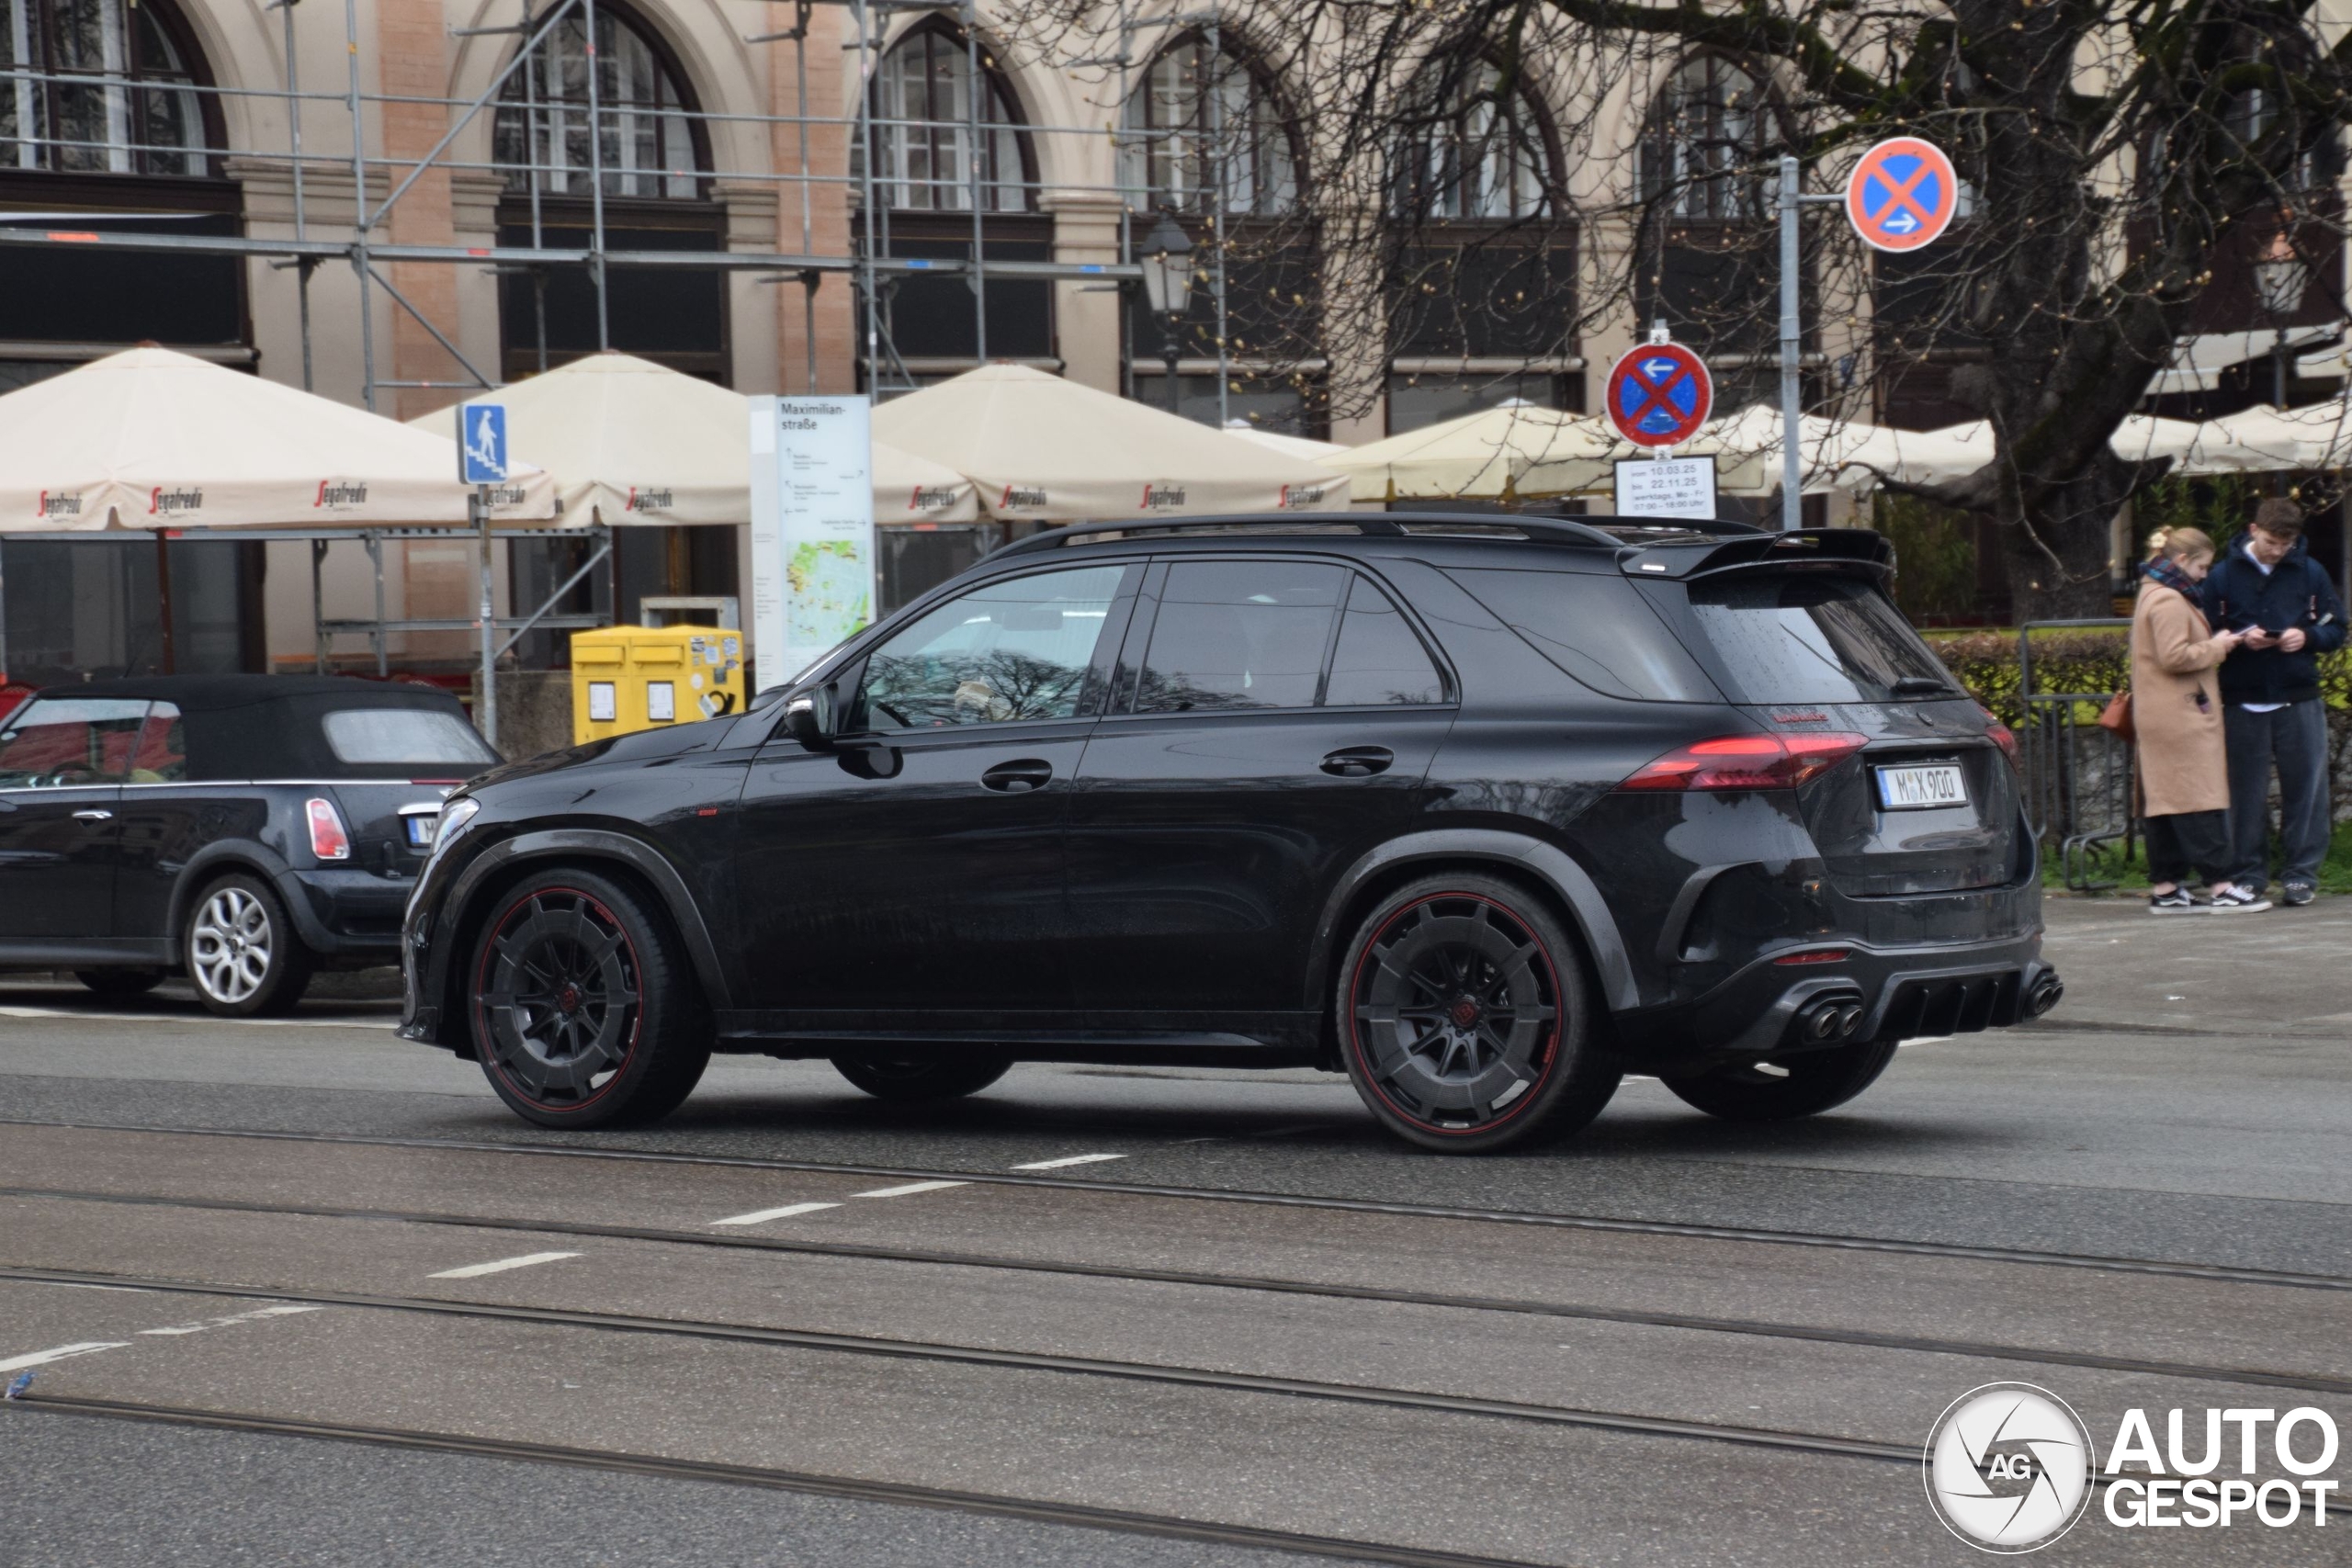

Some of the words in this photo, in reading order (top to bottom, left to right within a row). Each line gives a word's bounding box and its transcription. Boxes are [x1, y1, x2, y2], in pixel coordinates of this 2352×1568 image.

[781, 402, 846, 415] Maximilian-
[782, 418, 818, 430] straße
[1651, 464, 1697, 476] 10.03.25
[1651, 477, 1698, 489] 22.11.25
[1895, 772, 1910, 801] M
